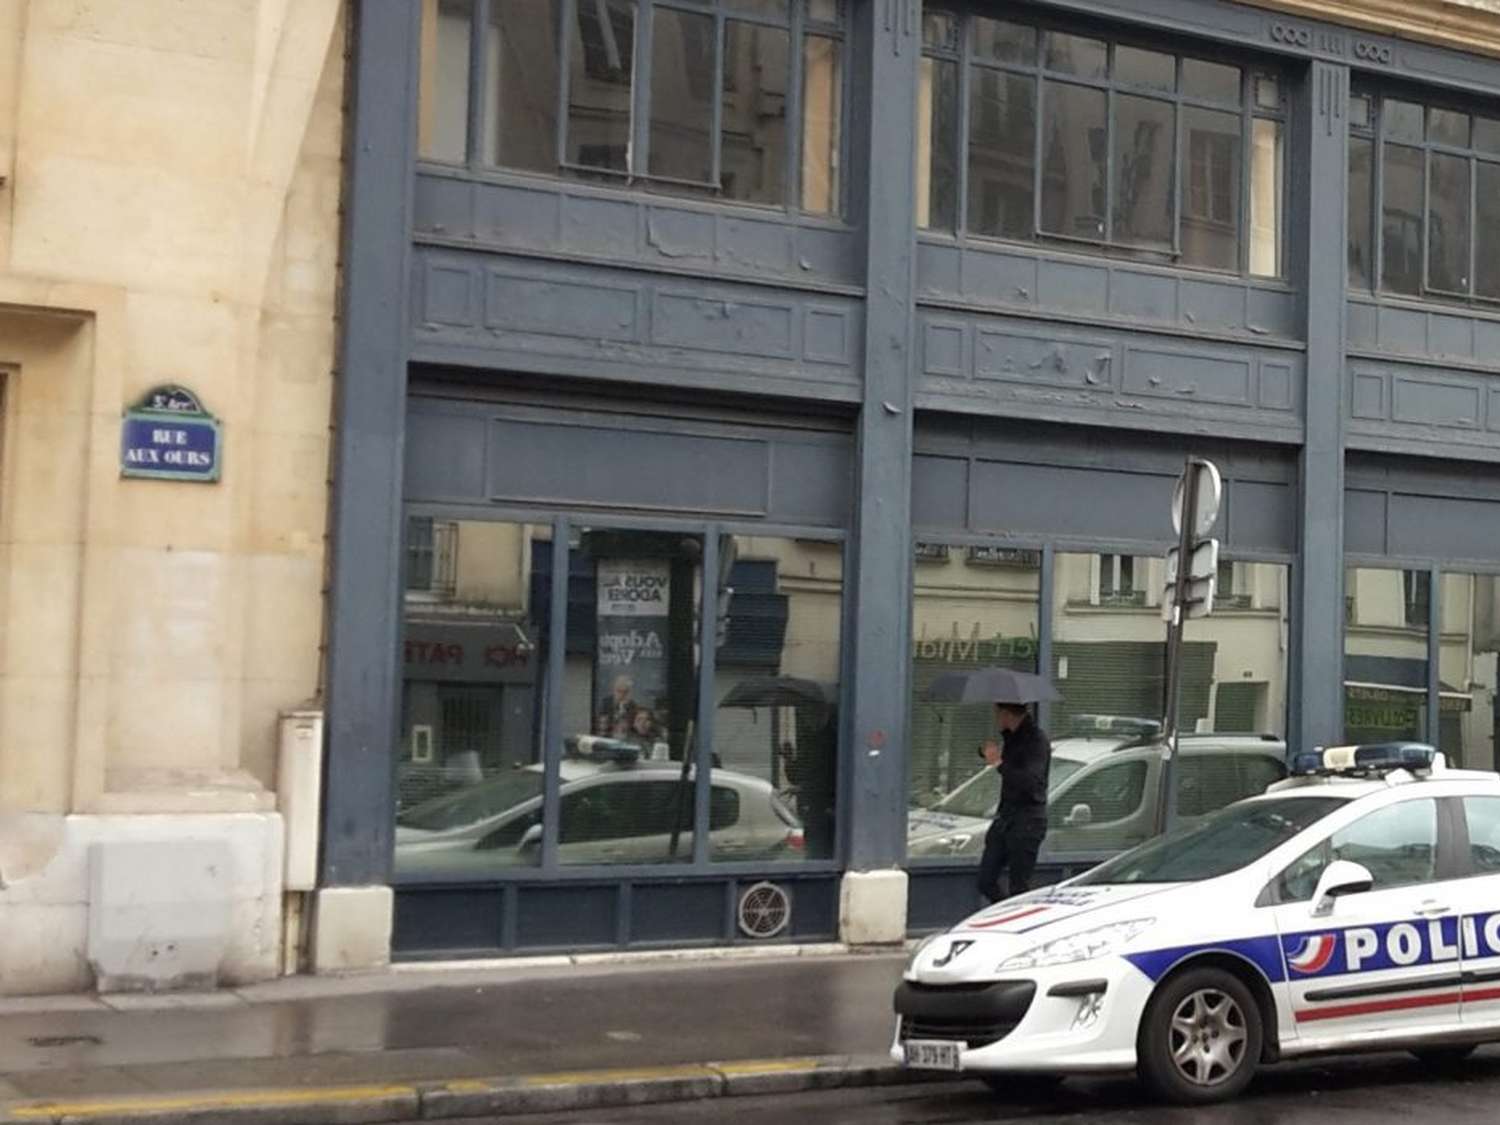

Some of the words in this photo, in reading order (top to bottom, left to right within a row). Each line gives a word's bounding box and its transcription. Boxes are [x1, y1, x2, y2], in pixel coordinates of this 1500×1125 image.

[152, 429, 188, 445] RUE
[127, 448, 160, 462] AUX
[163, 450, 211, 466] OURS
